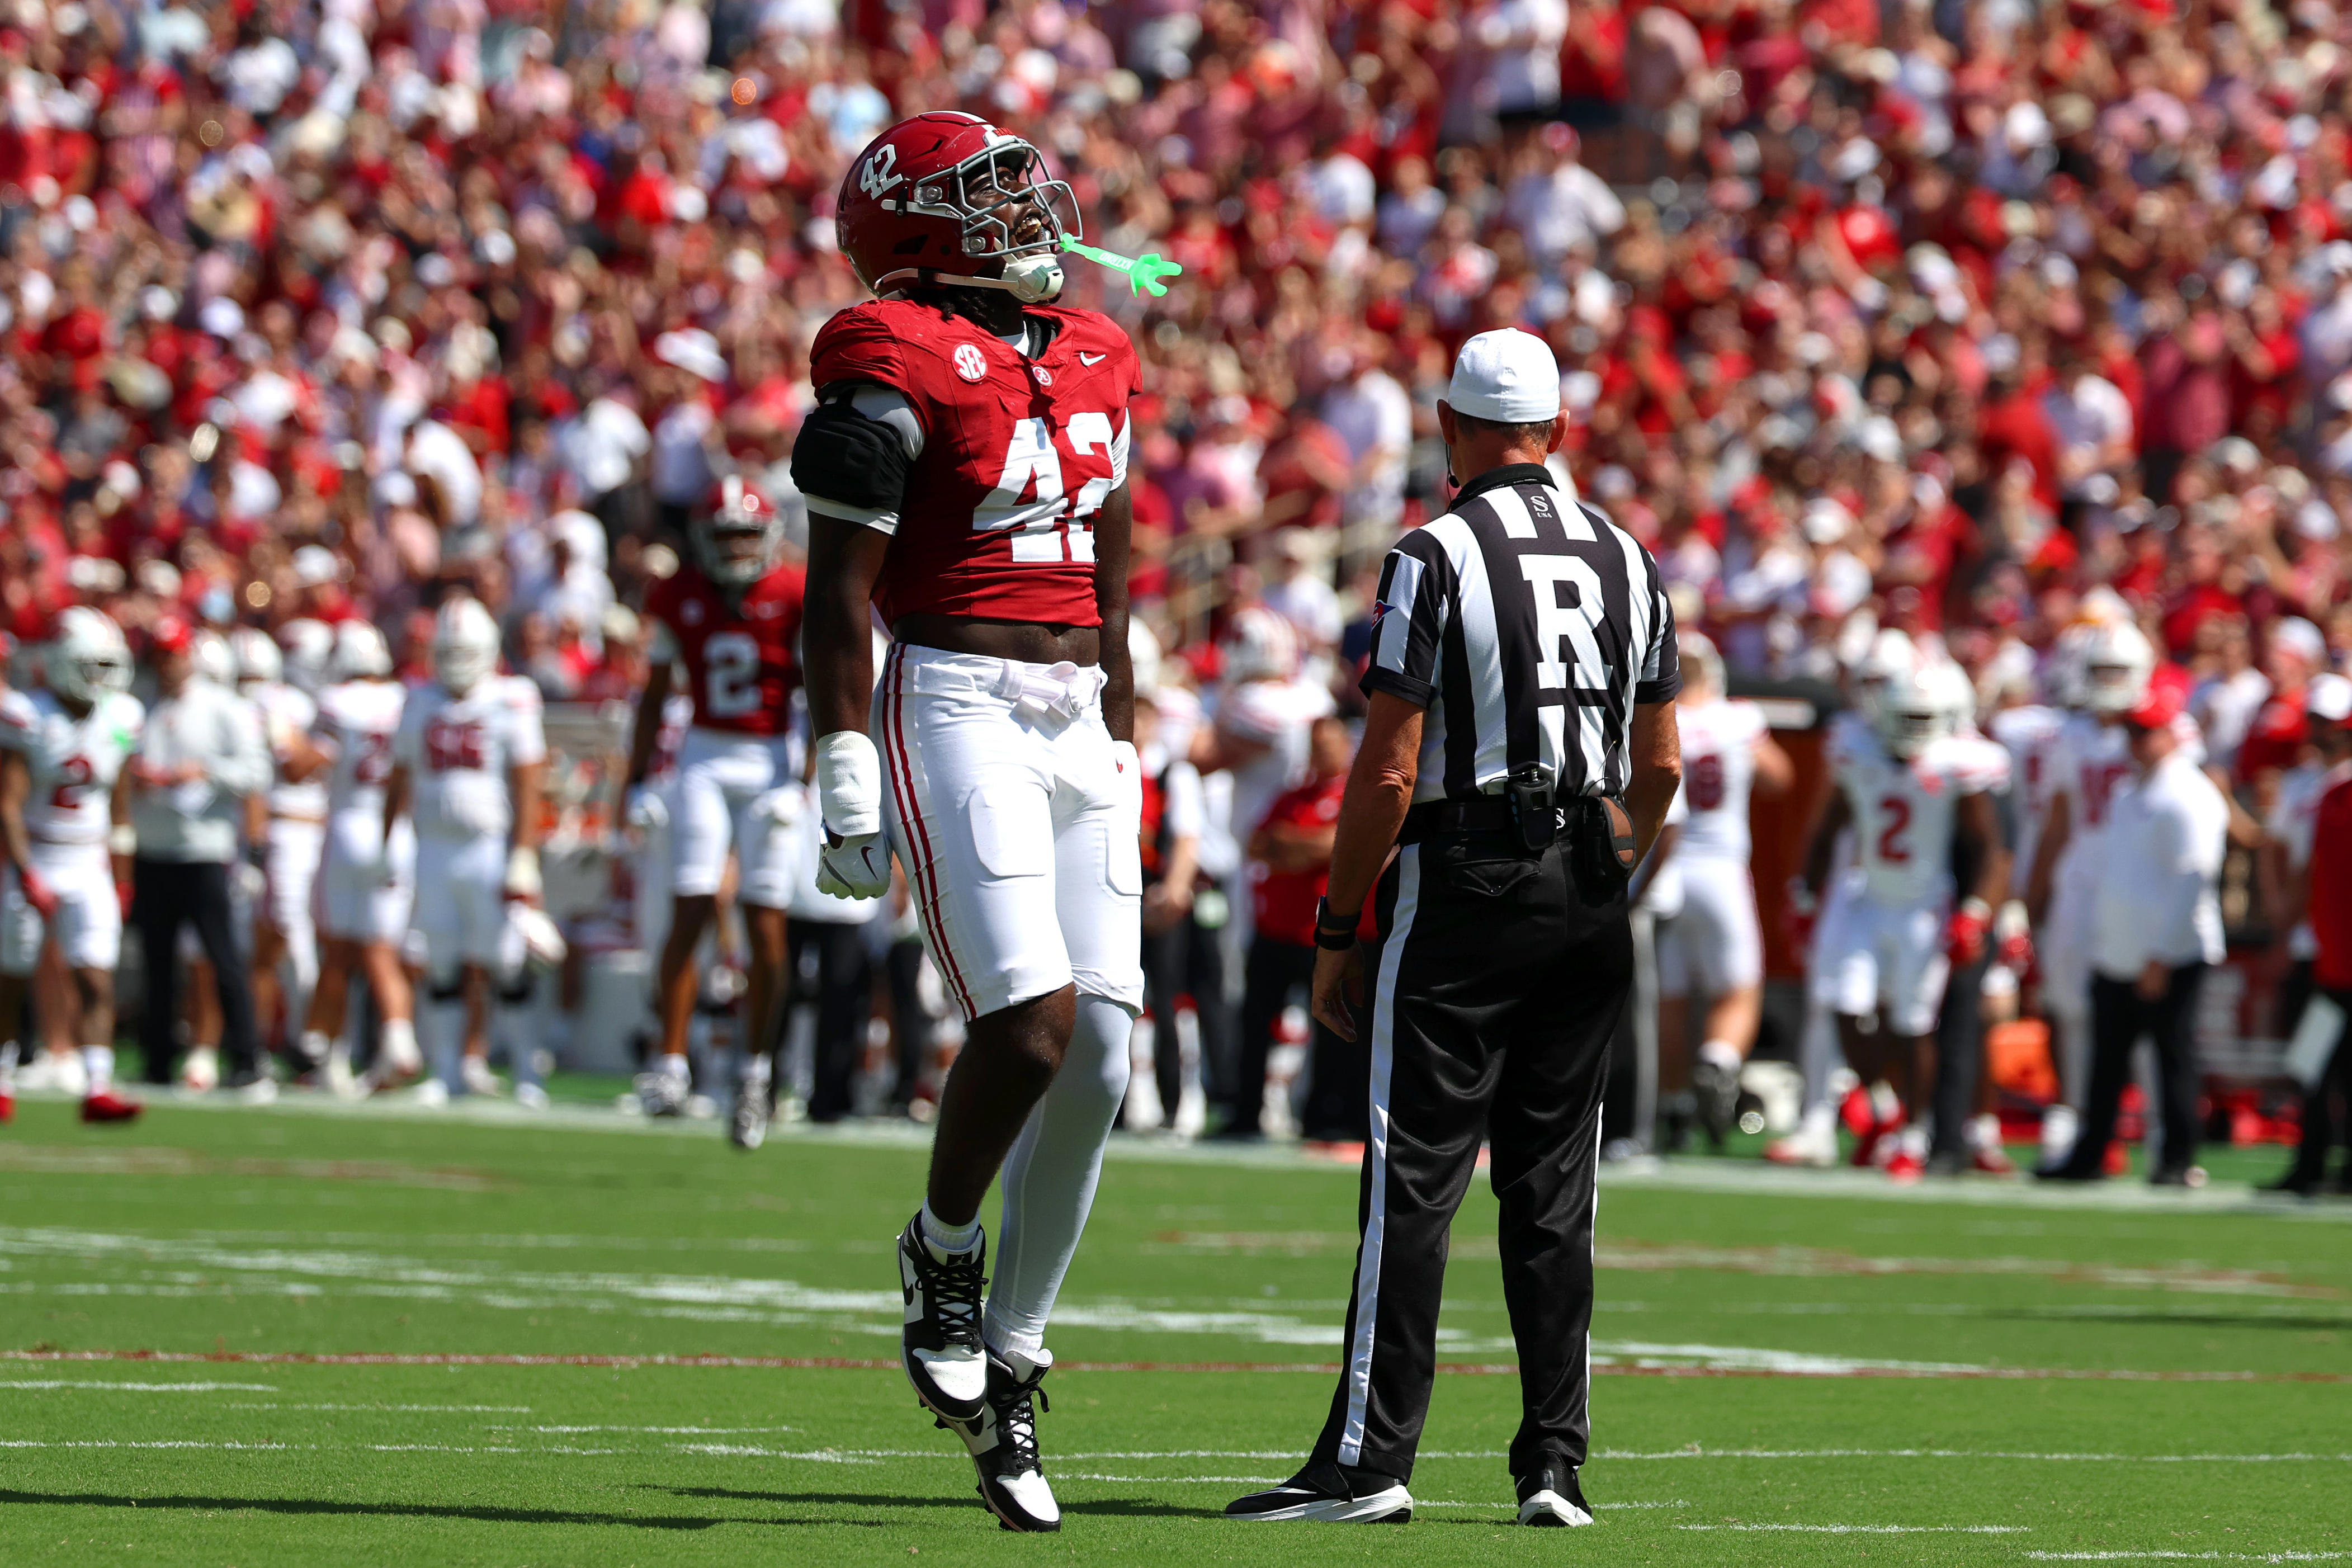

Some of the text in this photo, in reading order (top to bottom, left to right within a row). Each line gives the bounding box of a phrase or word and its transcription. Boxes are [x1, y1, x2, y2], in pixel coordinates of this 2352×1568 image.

[859, 143, 904, 200] 42
[954, 344, 986, 380] SEC
[972, 412, 1114, 563] 42
[1517, 554, 1614, 690] R
[702, 631, 763, 718] 2
[49, 753, 93, 810] 2
[1876, 796, 1911, 863] 2
